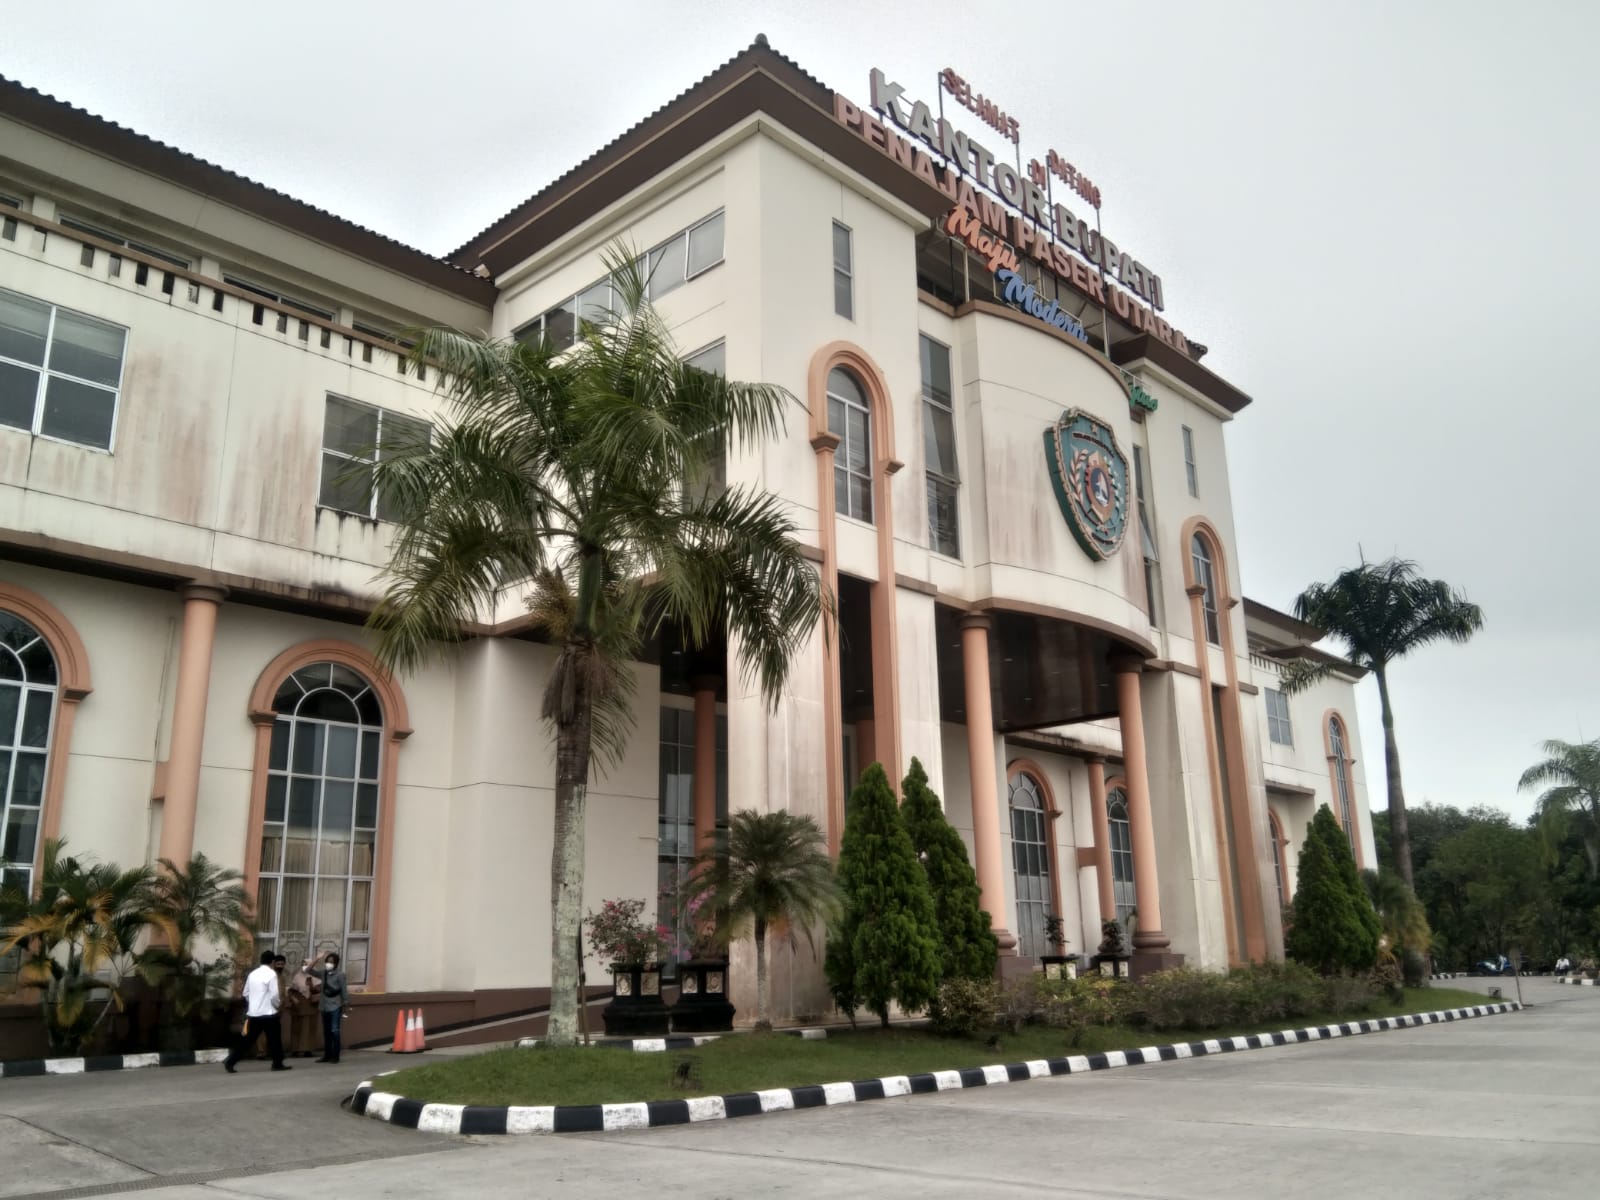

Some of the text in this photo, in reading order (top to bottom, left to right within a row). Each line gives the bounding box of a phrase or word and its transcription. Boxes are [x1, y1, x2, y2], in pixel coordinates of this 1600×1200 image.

[869, 67, 1165, 312] KANTOR BUPATI
[943, 67, 1020, 145] SELAMAT
[834, 93, 1190, 355] PENAJAM PASER UTARA
[945, 203, 1089, 345] Maju Modern
